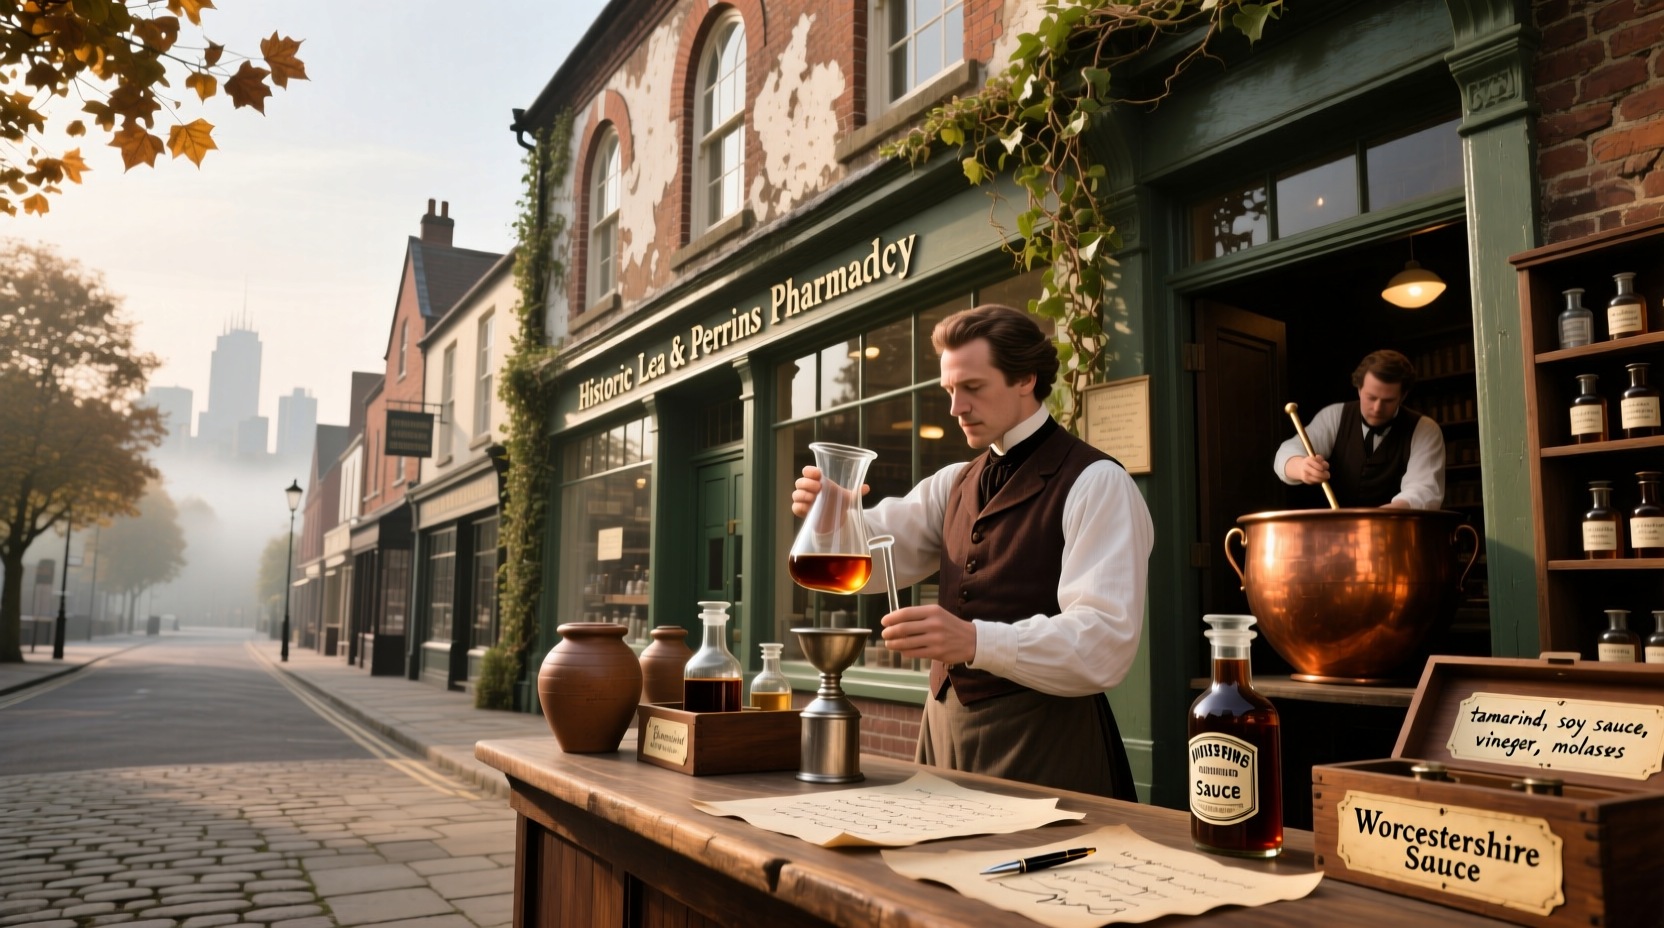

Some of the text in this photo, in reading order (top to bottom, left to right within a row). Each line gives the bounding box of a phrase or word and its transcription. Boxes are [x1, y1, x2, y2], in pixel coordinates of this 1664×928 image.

[578, 233, 916, 411] Historic Lea & Perrins Pharmadcy
[1470, 706, 1648, 738] tamarind, soy sauce,
[1196, 780, 1241, 800] Sauce
[1354, 807, 1540, 867] Worcestershire
[1404, 845, 1481, 882] Sauce
